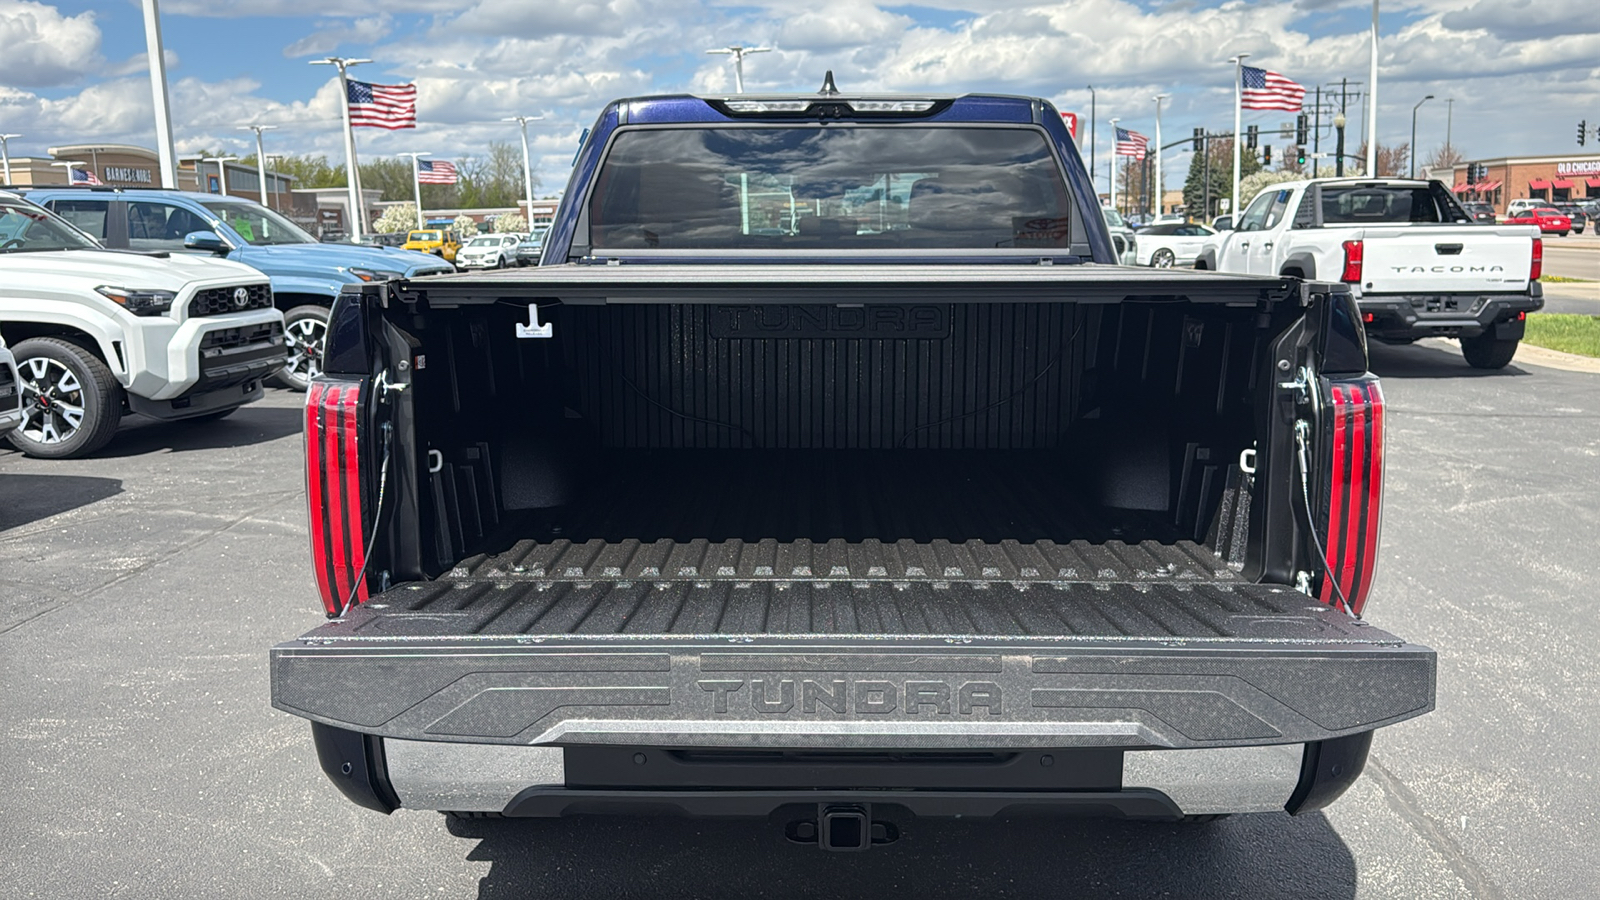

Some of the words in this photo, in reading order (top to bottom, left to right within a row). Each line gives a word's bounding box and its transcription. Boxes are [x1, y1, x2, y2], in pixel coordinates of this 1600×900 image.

[105, 167, 132, 182] BARNES
[1557, 162, 1572, 174] OLD
[717, 305, 943, 332] TUNDRA
[697, 679, 1003, 715] TUNDRA
